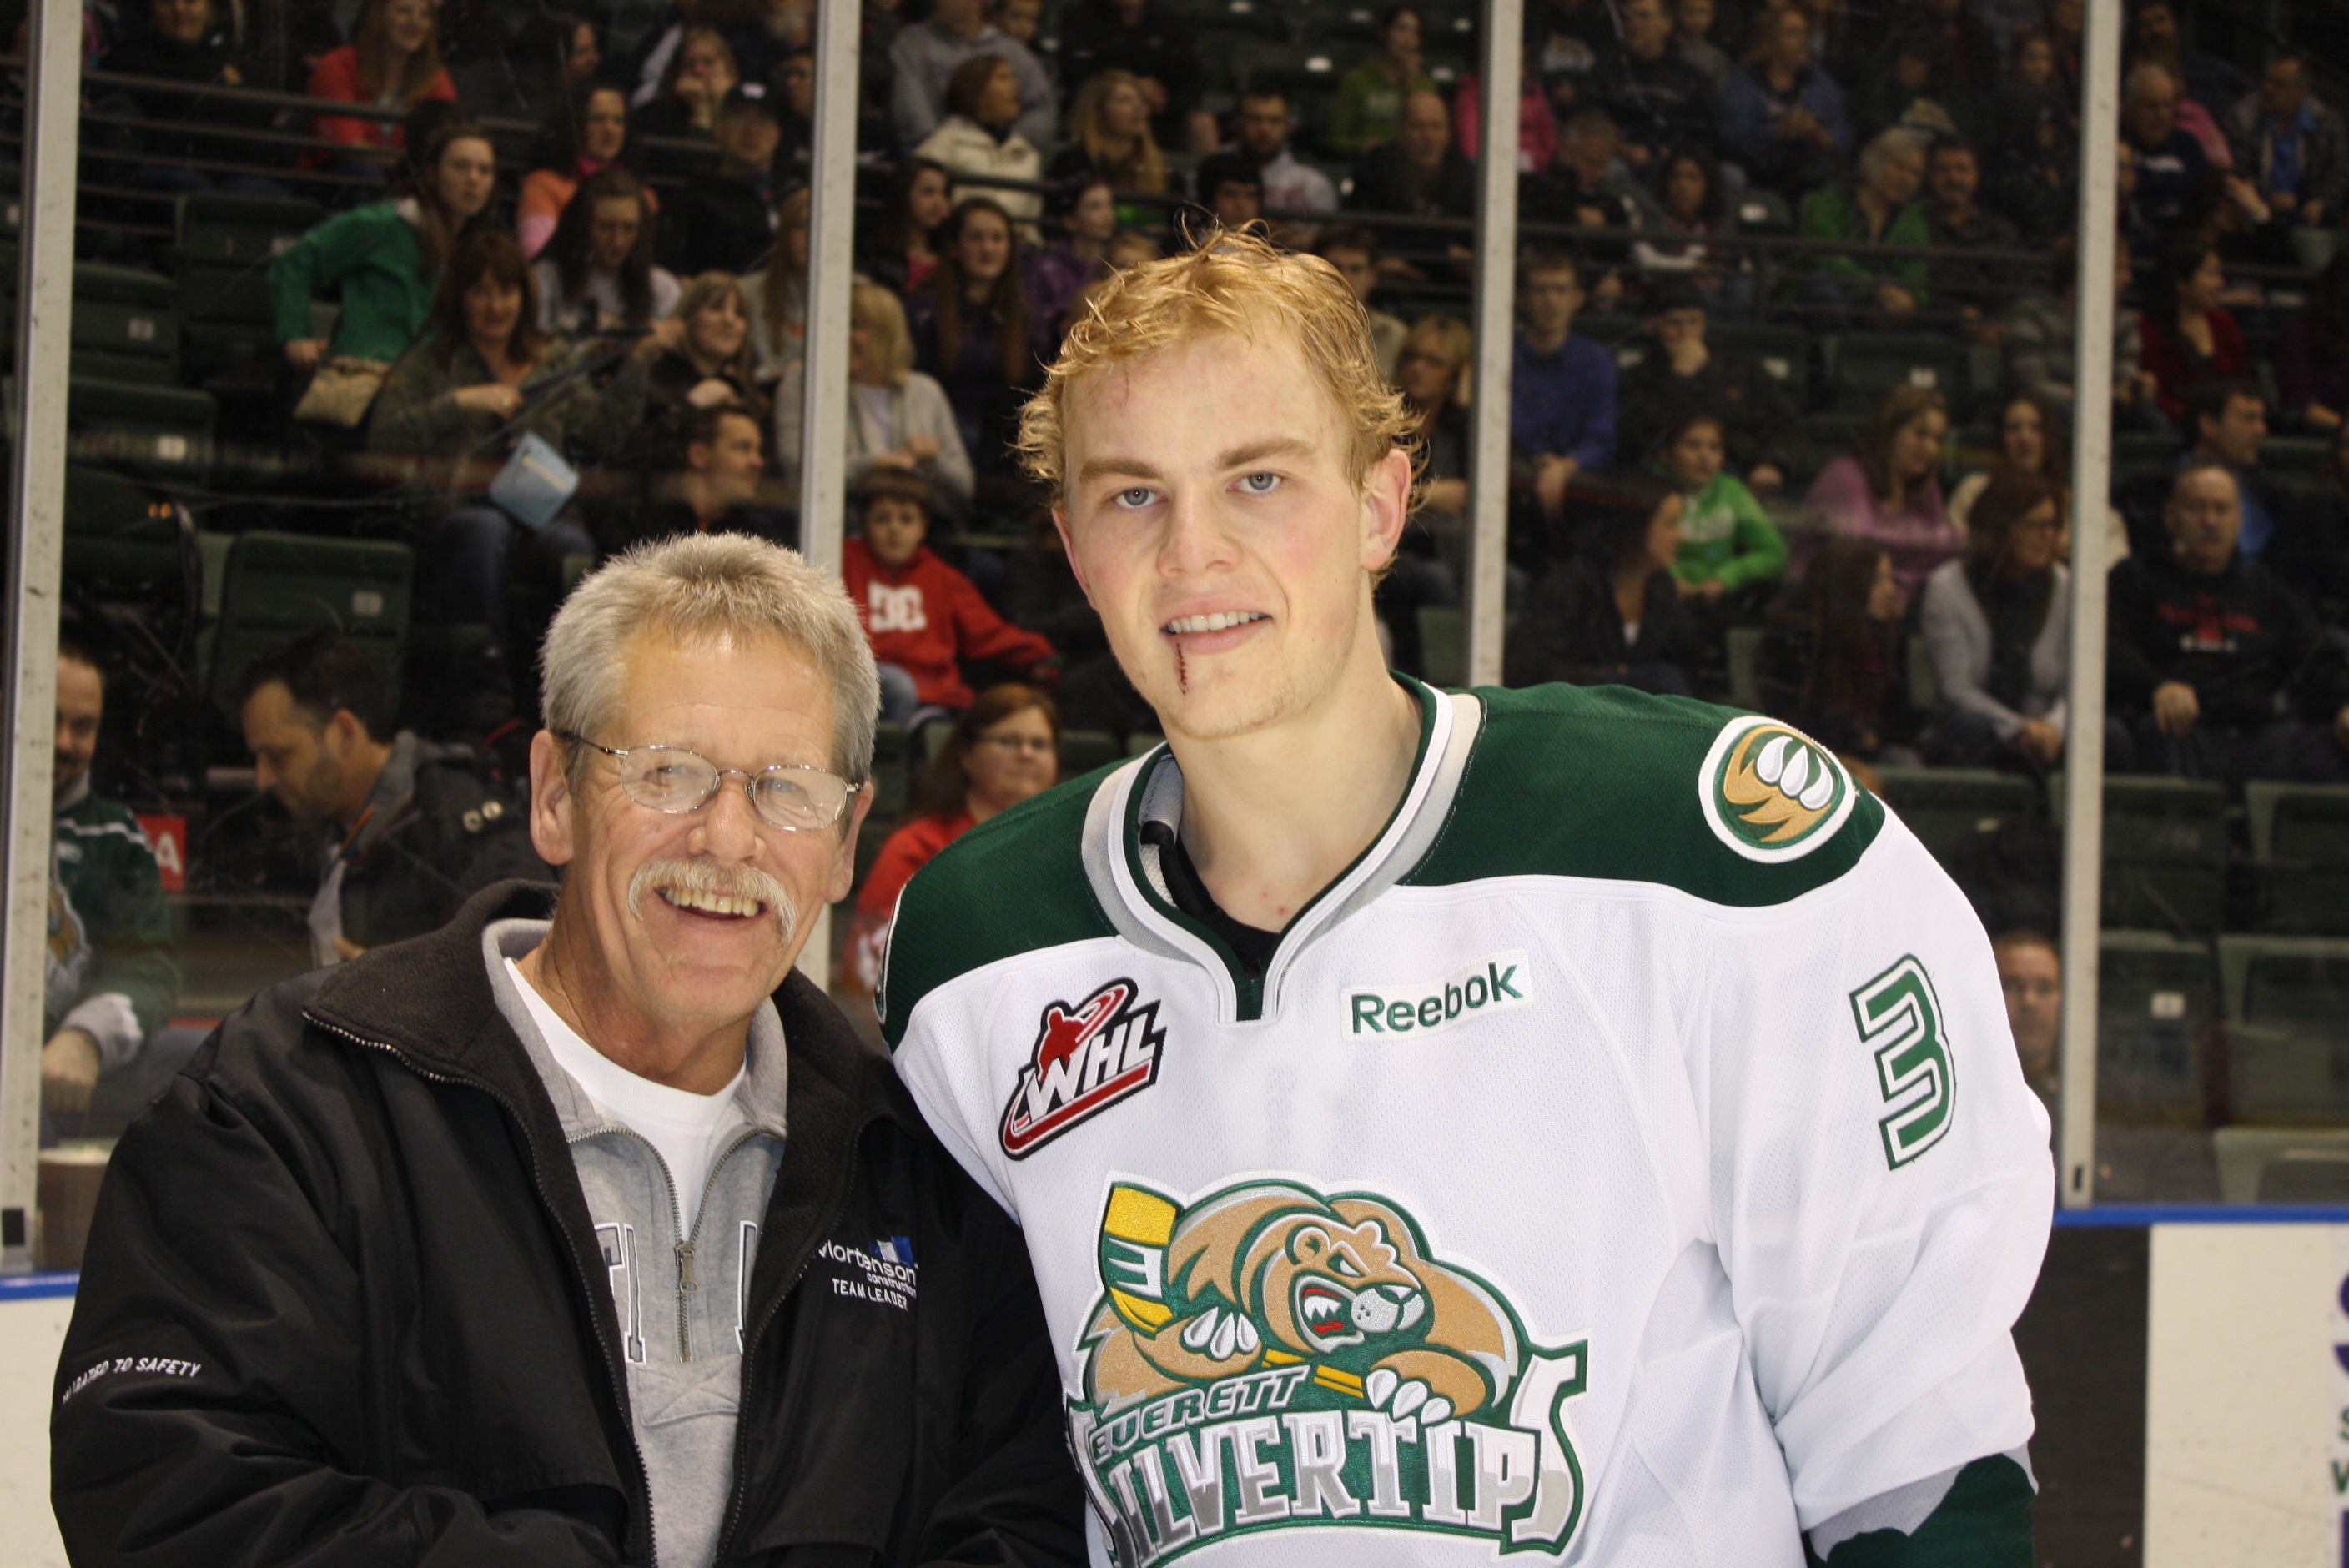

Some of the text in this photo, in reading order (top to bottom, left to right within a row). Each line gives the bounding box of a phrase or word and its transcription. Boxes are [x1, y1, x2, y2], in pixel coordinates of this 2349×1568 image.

[868, 581, 928, 633] DC
[1351, 961, 1523, 1033] Reebok
[1023, 1013, 1156, 1124] WHL
[1849, 953, 1956, 1170] 3
[832, 1277, 908, 1312] TEAM LEADER
[113, 1356, 133, 1374] TO
[135, 1356, 202, 1378] SAFETY
[1089, 1365, 1310, 1465] EVERETT
